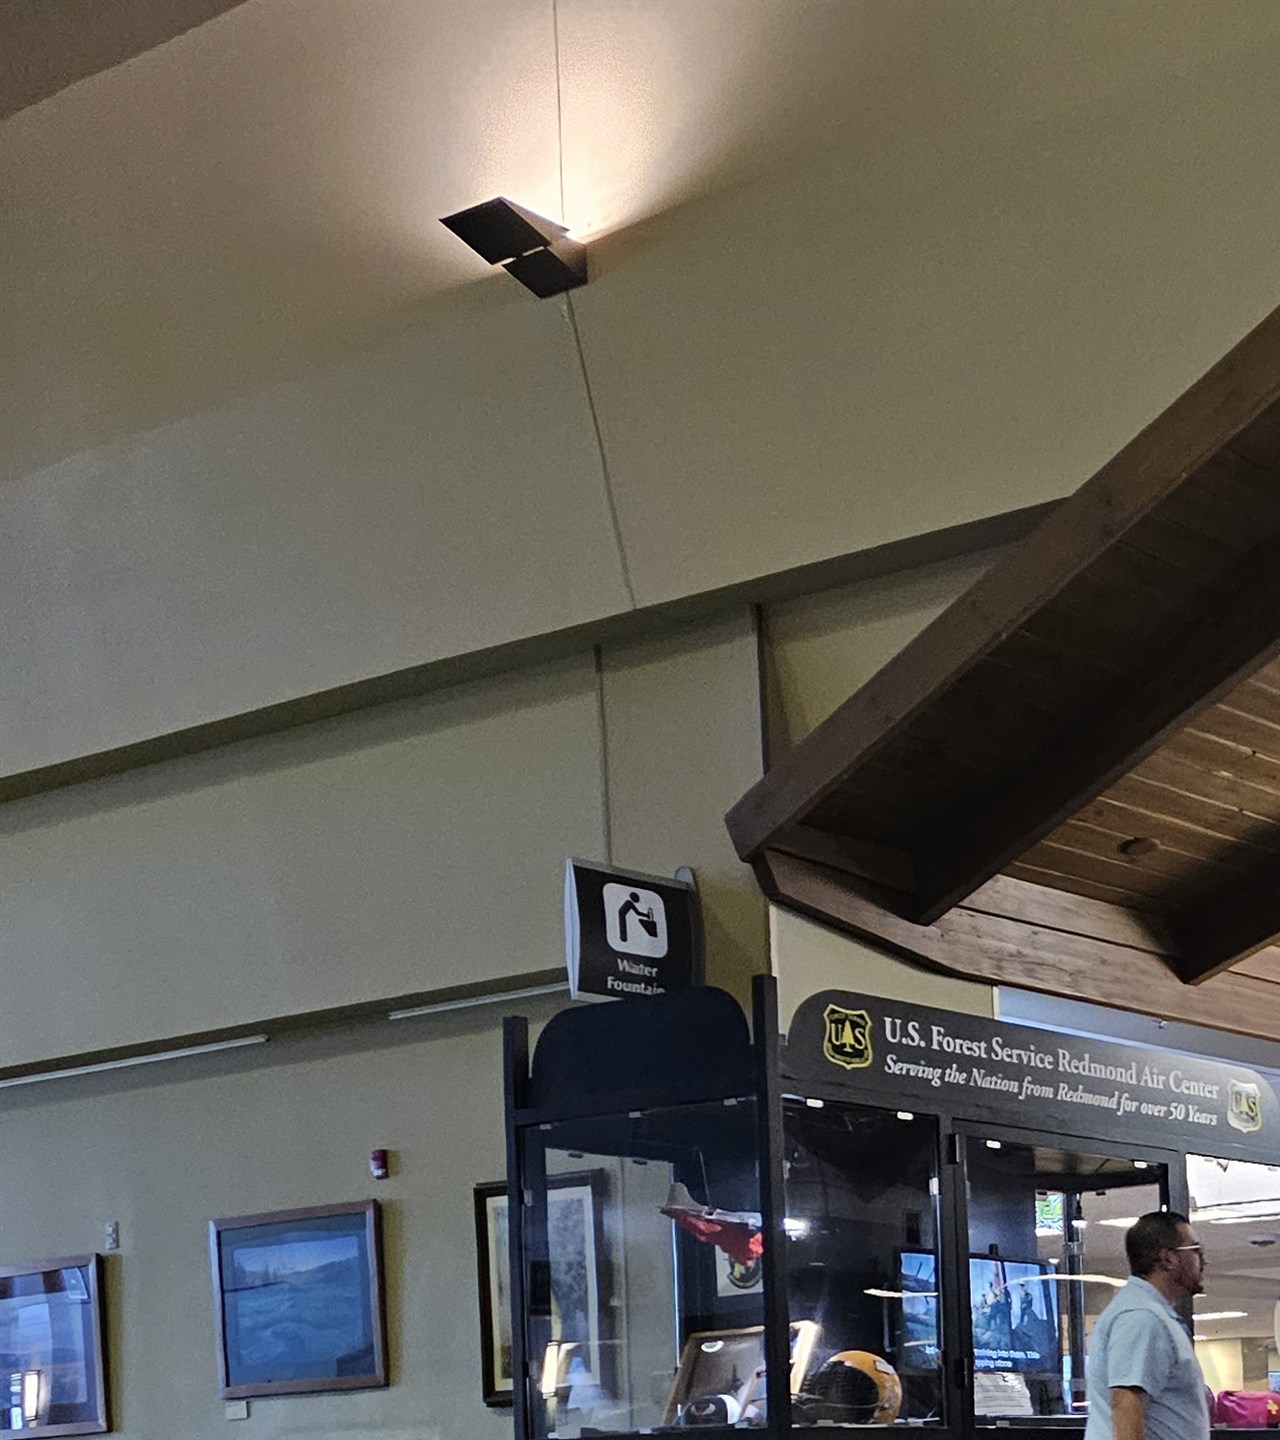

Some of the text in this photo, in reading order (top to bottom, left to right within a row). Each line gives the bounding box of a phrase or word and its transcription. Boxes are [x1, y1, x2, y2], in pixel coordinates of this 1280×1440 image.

[617, 957, 659, 977] Water
[883, 1017, 1220, 1100] U.S. Forest Service Redmond Air Center
[884, 1054, 1218, 1126] Serving the Nation from Redmond for over 50 Years
